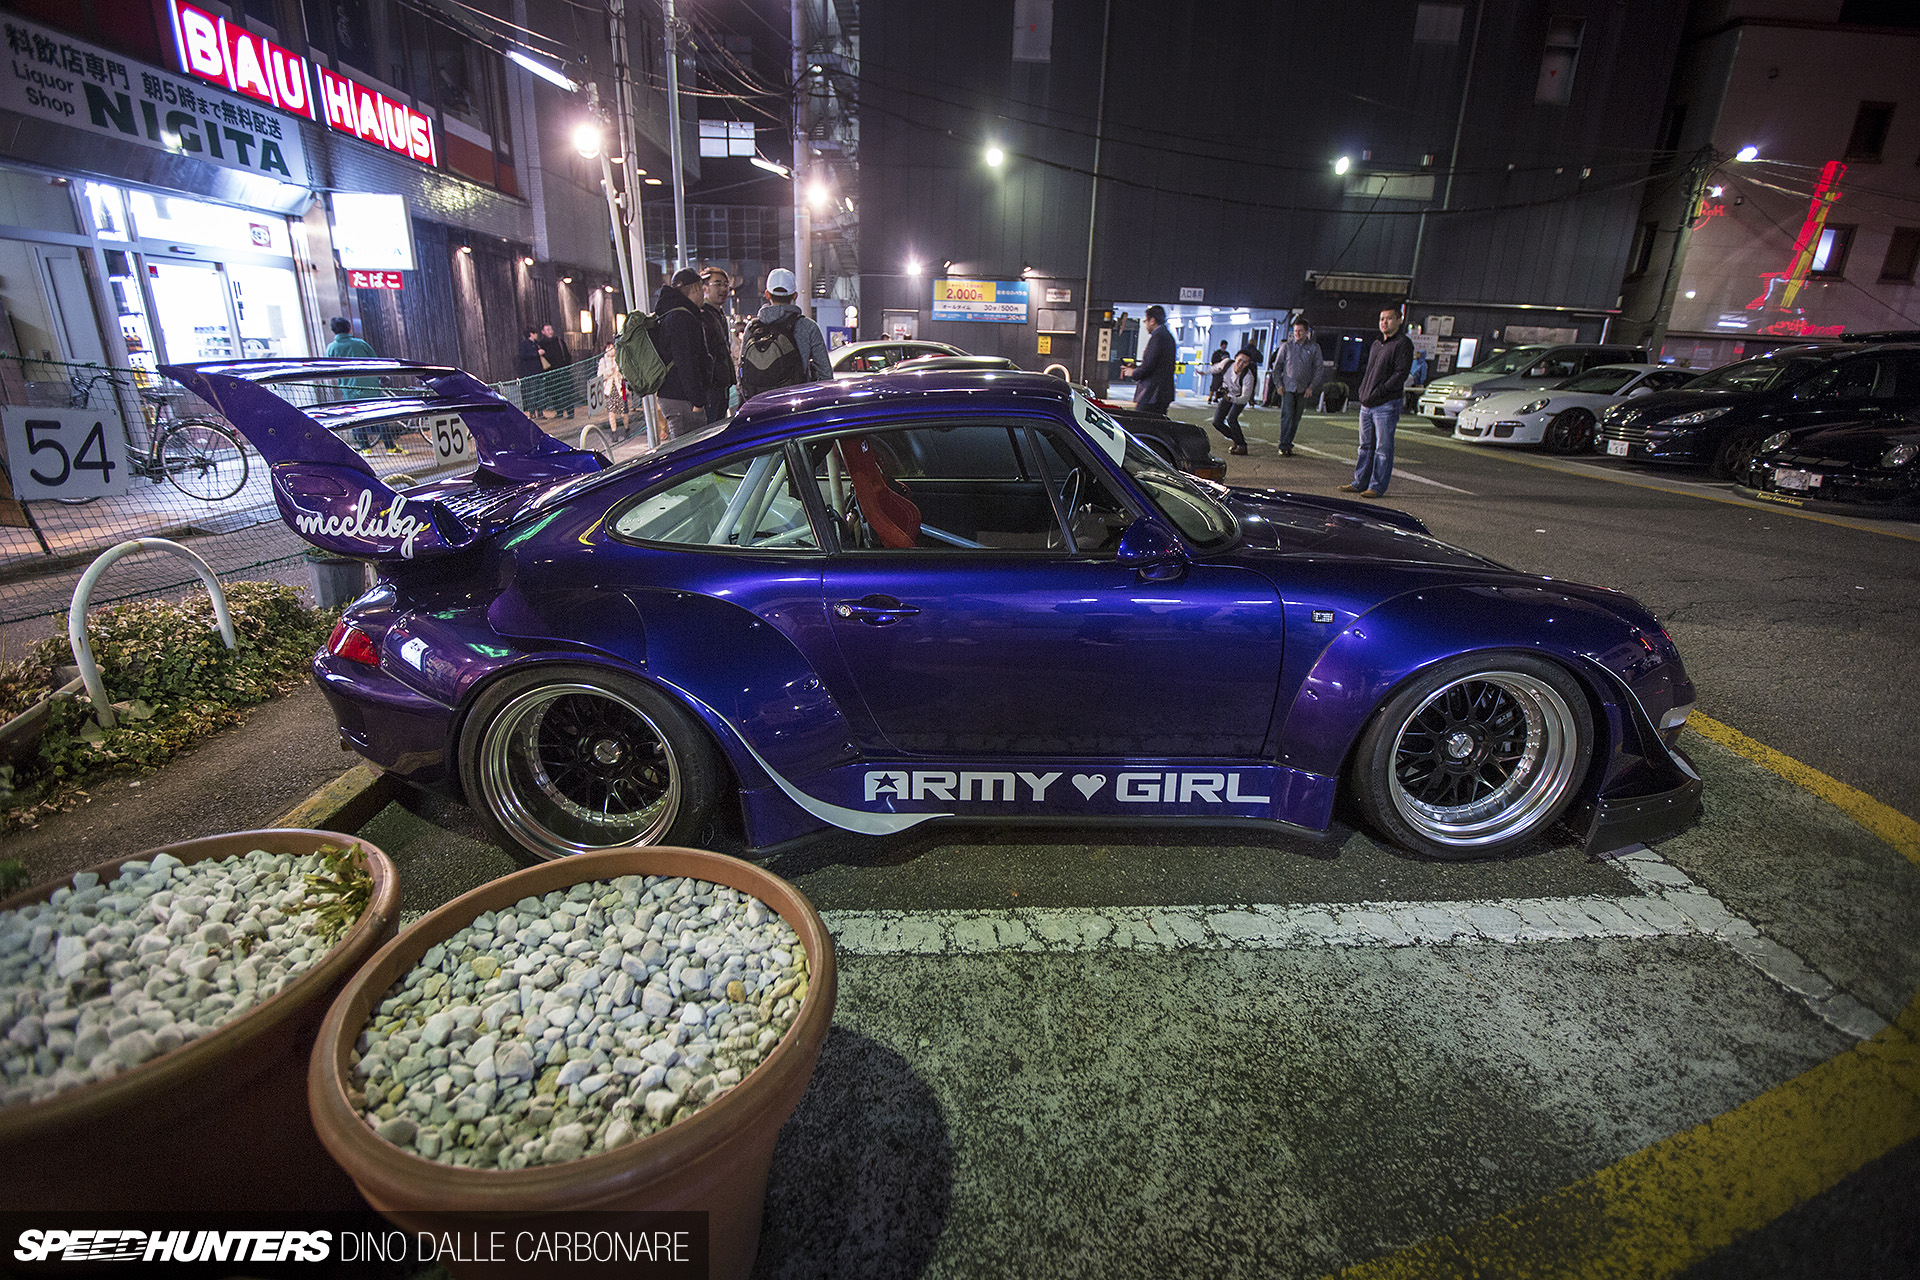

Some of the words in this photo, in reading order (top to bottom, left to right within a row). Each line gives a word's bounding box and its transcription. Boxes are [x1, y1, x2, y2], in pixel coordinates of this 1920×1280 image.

[12, 60, 75, 95] Liquor
[182, 7, 305, 110] BAU
[325, 74, 430, 159] HAUS
[25, 86, 76, 118] Shop
[140, 71, 284, 141] 朝5時まで無料配送
[82, 80, 292, 178] NIGITA
[352, 271, 401, 289] たばこ
[590, 380, 604, 410] 56
[24, 418, 117, 487] 54
[436, 418, 464, 457] 55
[864, 771, 1063, 802] ARMY
[1116, 773, 1271, 804] GIRL
